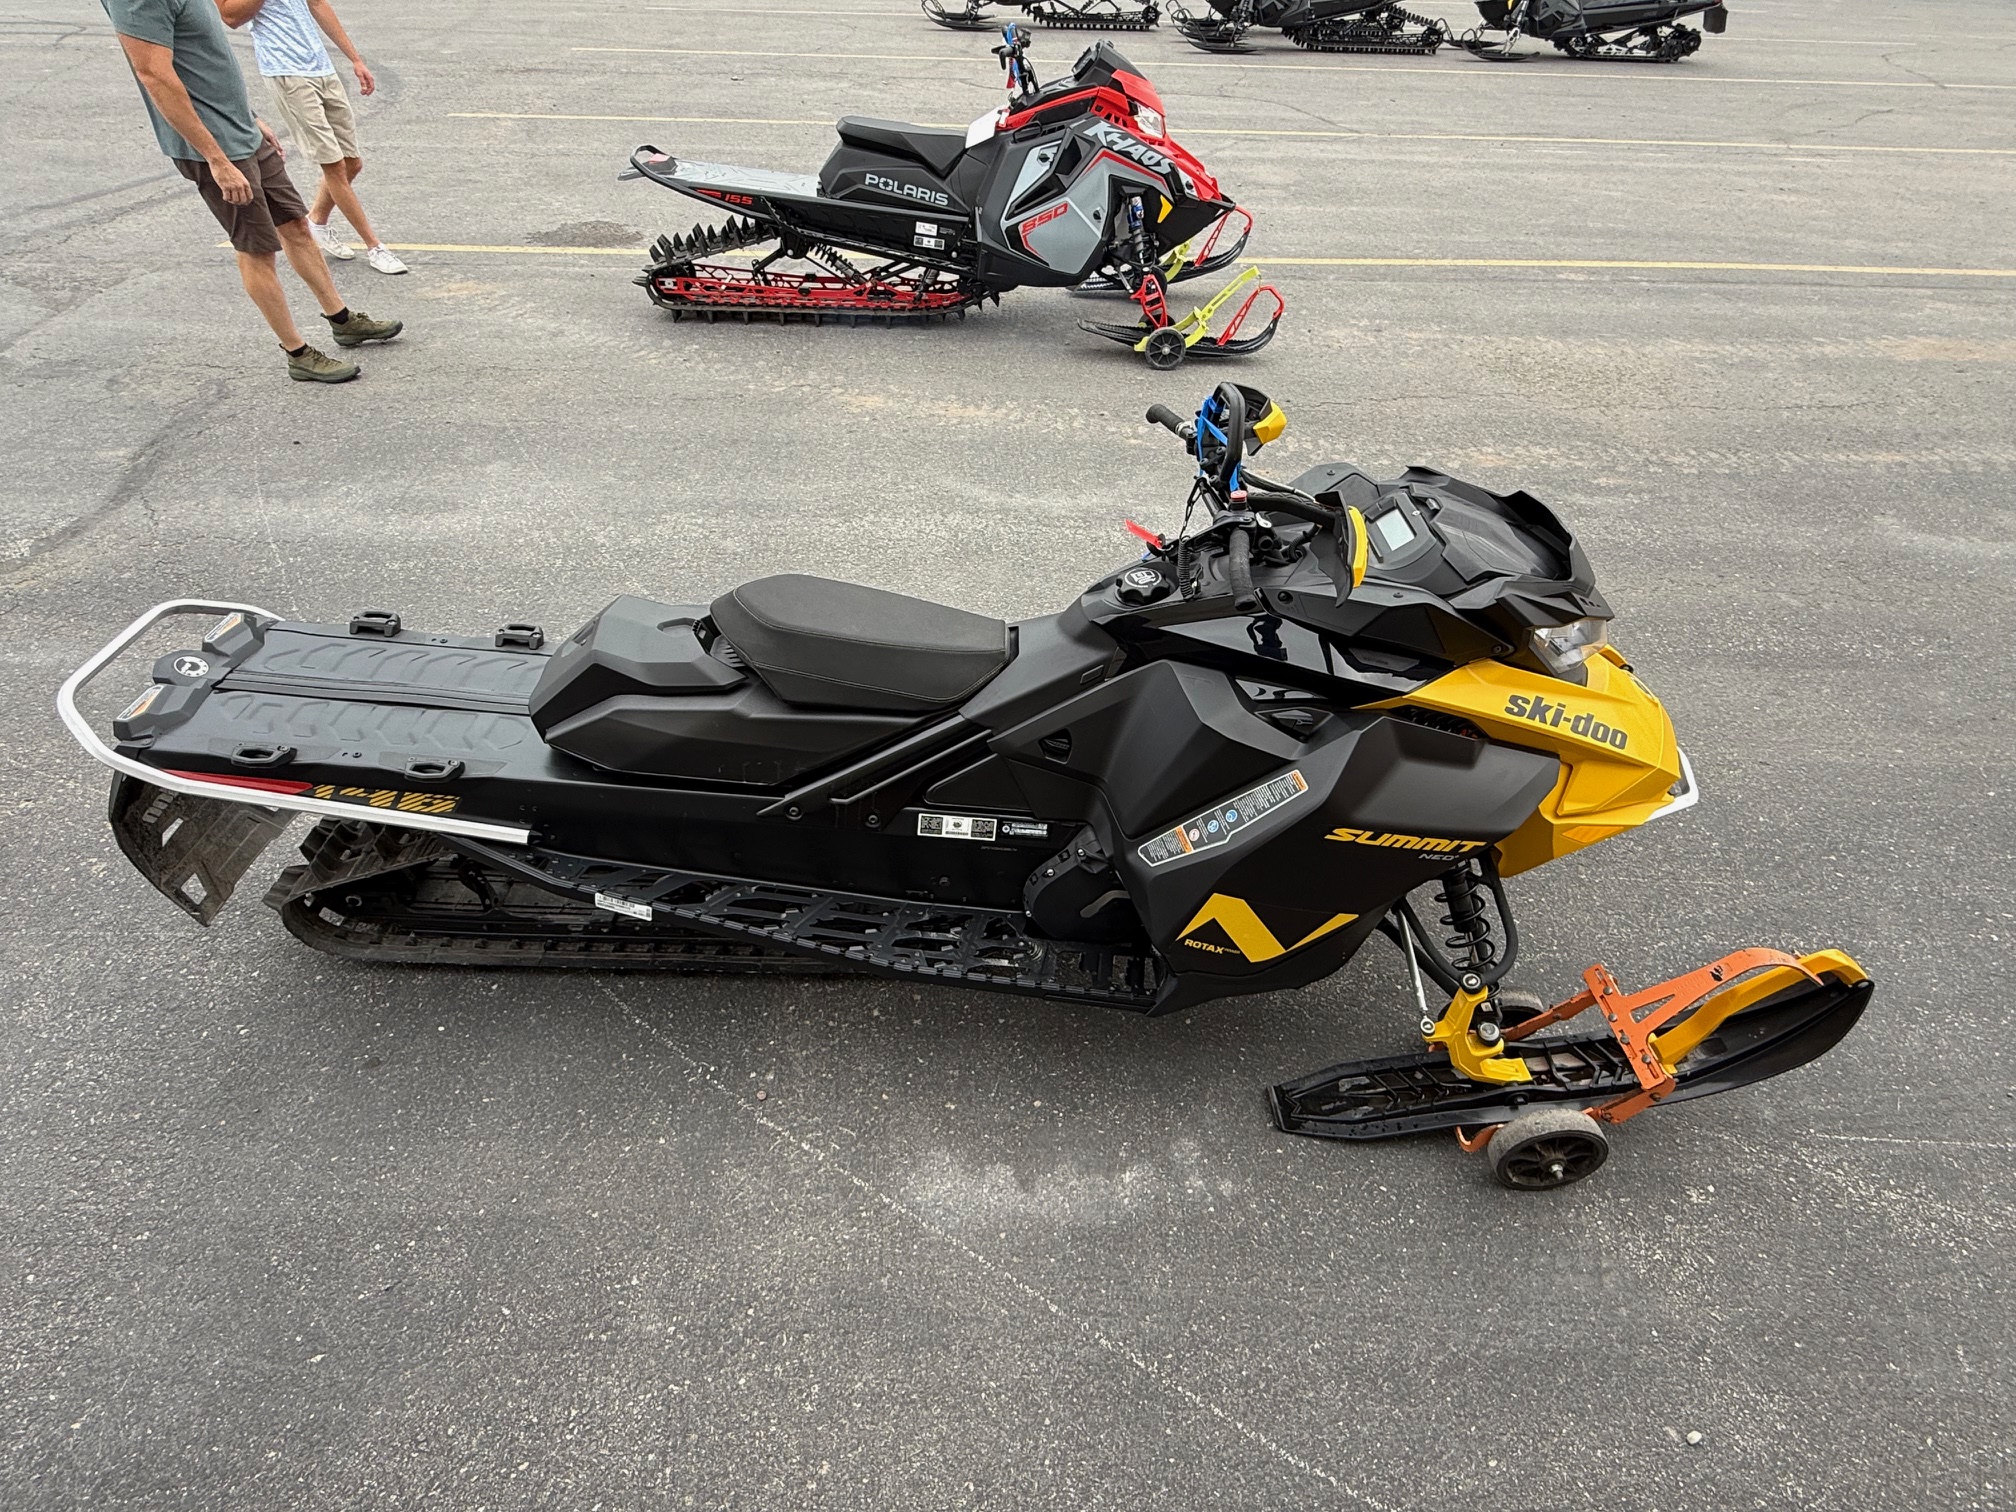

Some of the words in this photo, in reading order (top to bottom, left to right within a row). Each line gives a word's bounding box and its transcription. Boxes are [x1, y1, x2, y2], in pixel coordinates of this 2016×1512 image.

[1082, 120, 1176, 174] KHAOS
[724, 193, 754, 205] 155
[865, 173, 949, 206] POLARIS
[1021, 202, 1069, 234] 850
[1504, 694, 1628, 750] ski-doo
[1324, 828, 1487, 853] SUMMIT
[1184, 938, 1225, 955] ROTAX
